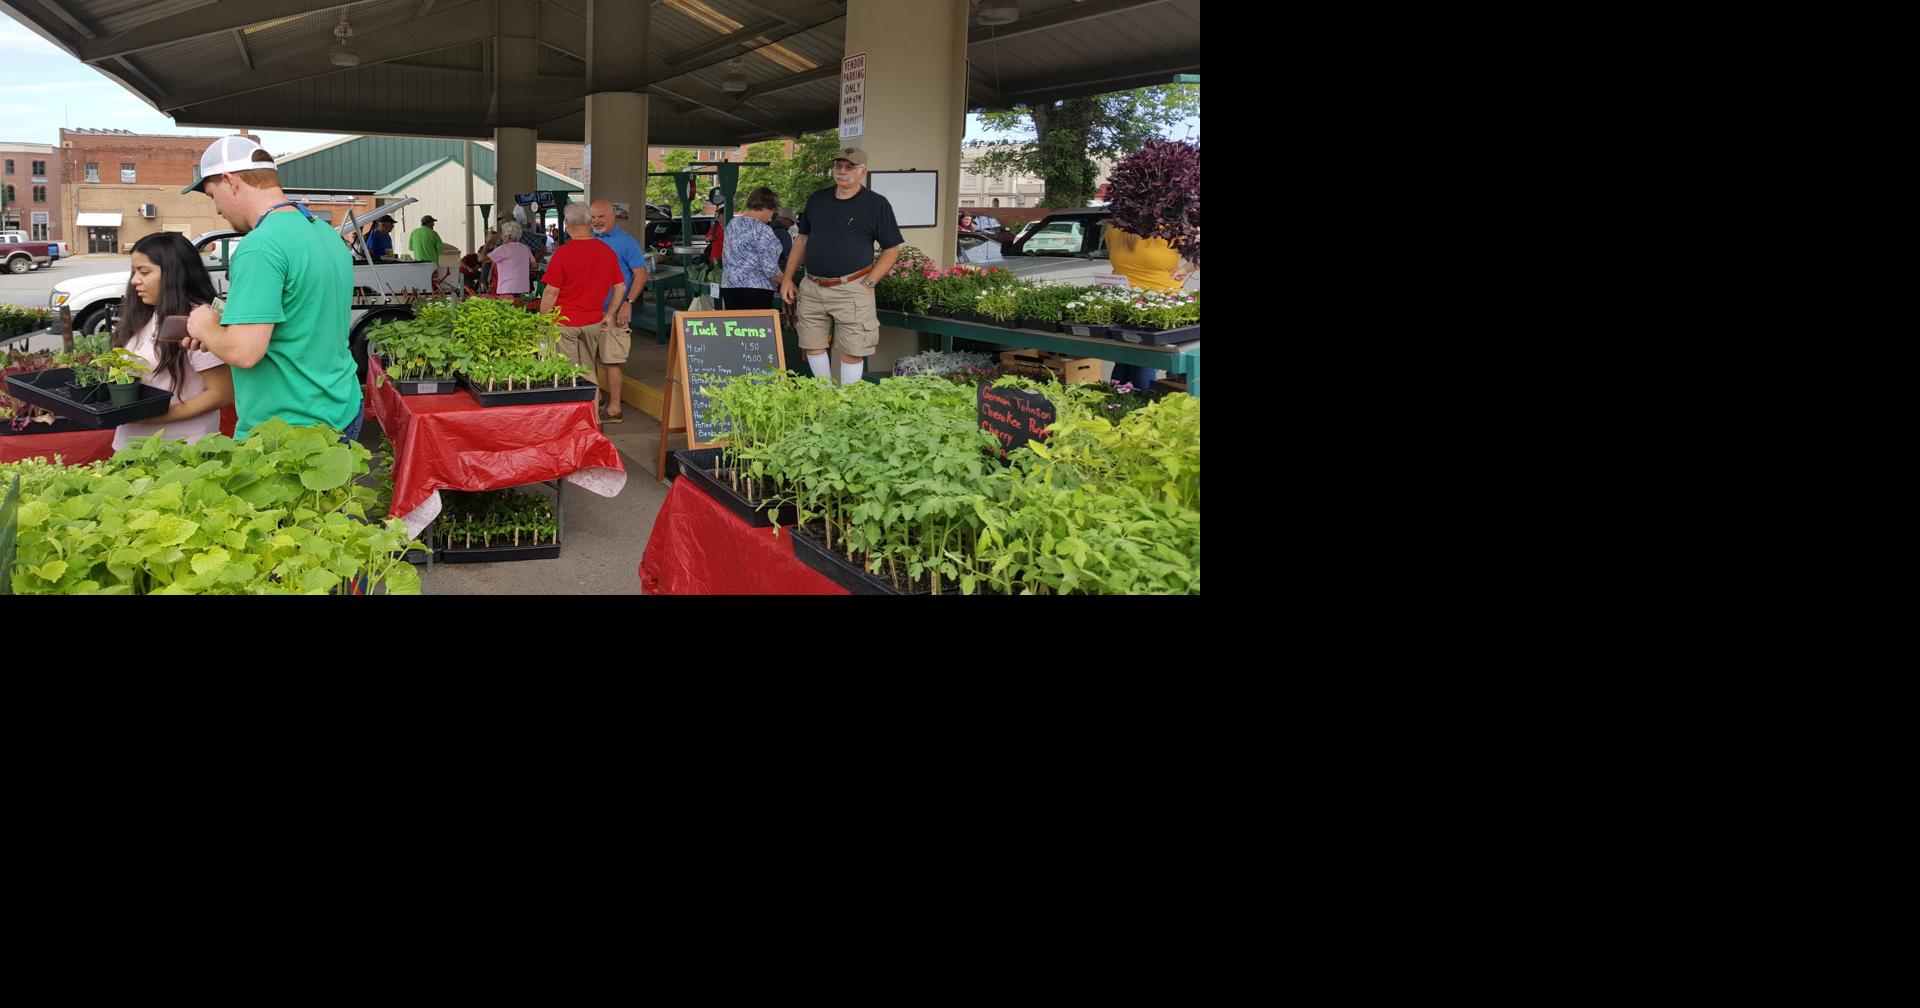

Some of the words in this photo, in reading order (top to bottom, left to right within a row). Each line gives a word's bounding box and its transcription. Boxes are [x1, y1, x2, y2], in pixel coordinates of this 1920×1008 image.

[844, 57, 864, 70] VENDOR
[843, 69, 865, 82] PARKING
[845, 82, 860, 94] ONLY
[686, 320, 719, 336] Tuck
[724, 321, 767, 338] Farms
[688, 354, 704, 365] Tray
[982, 420, 1014, 447] Cherry
[1029, 417, 1052, 438] Purpl
